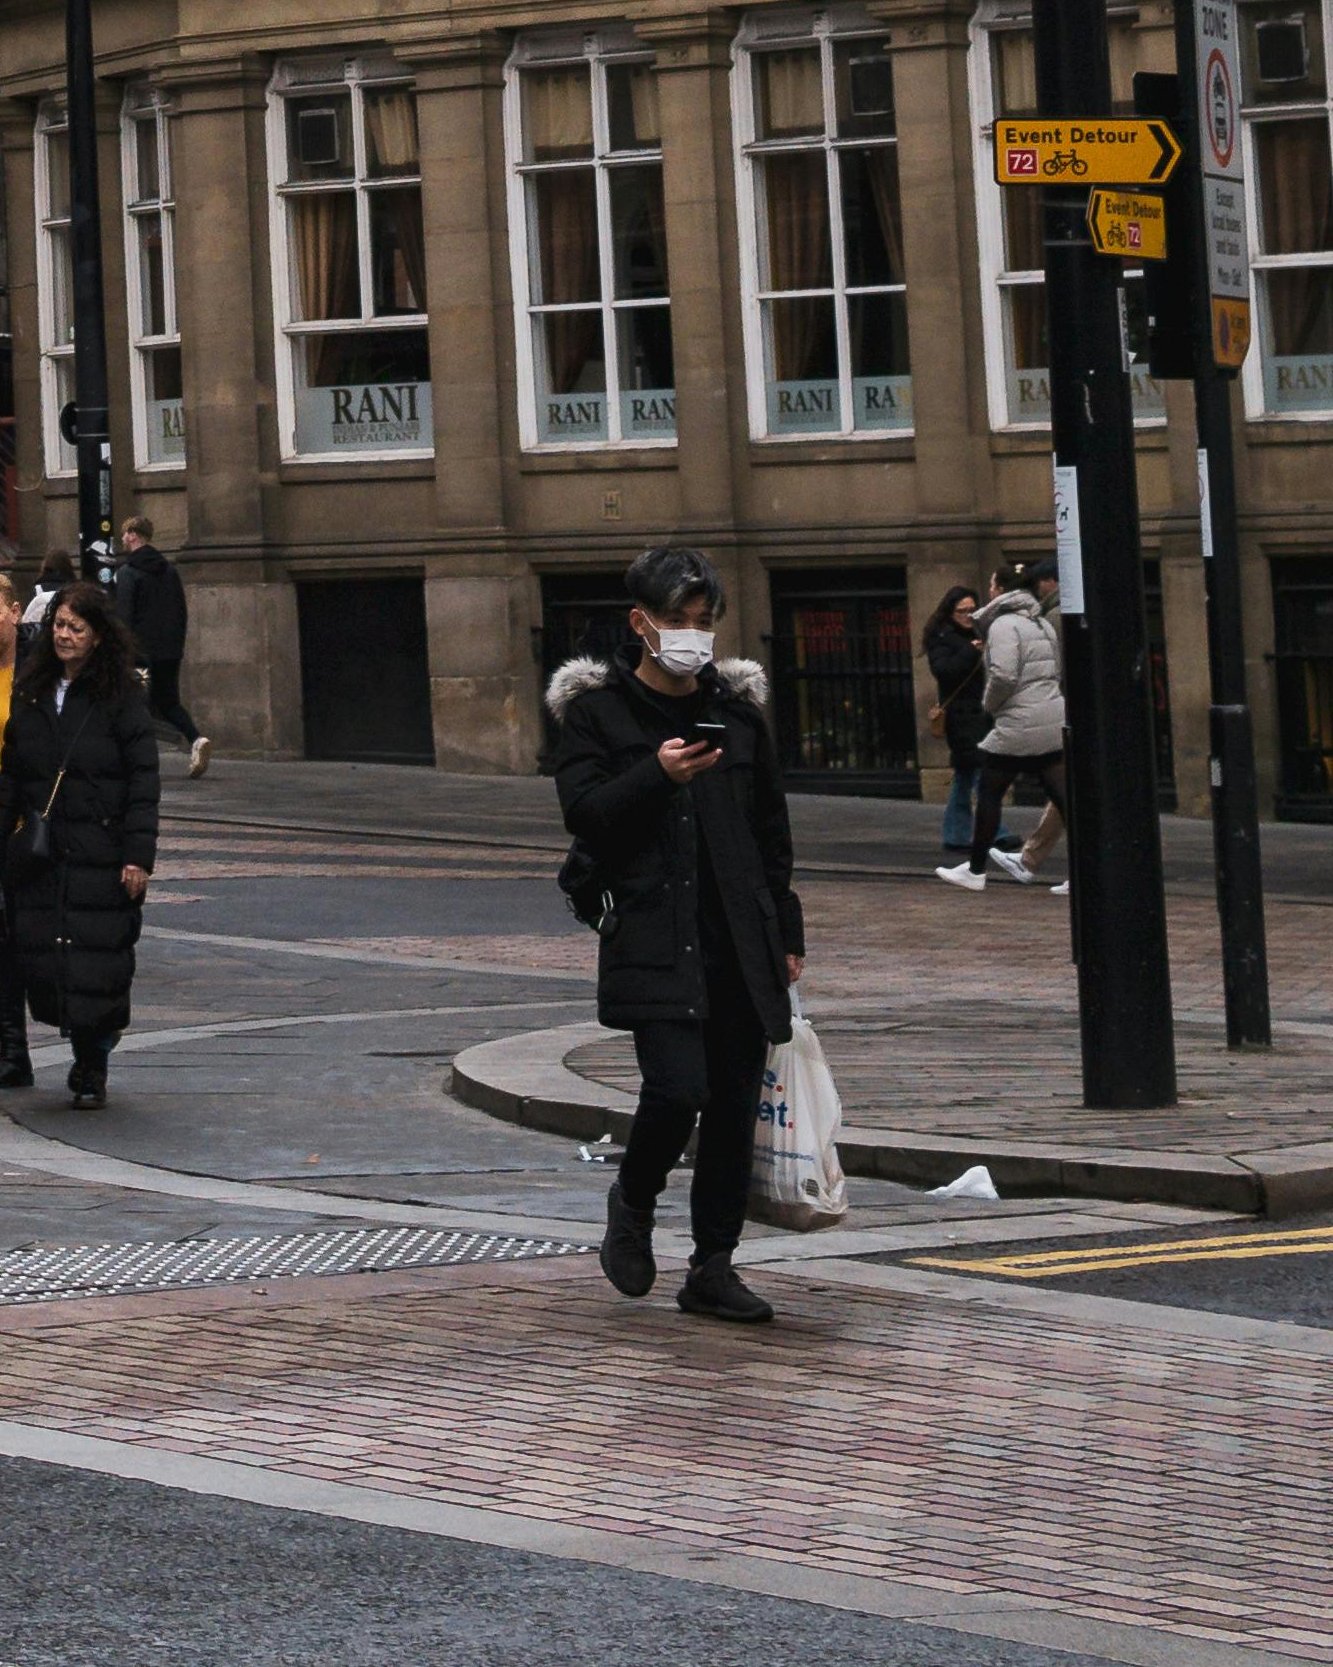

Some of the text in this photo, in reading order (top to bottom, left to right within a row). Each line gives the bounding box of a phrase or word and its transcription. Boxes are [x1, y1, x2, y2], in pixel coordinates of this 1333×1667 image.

[1202, 6, 1228, 41] ZONE
[1005, 127, 1138, 144] Event Detour
[1009, 154, 1033, 171] 72
[1106, 198, 1162, 219] Event Detour
[1129, 226, 1141, 245] 72
[331, 385, 419, 424] RANI
[631, 398, 677, 421] RAN
[778, 388, 833, 412] RANI
[547, 401, 600, 425] RANI
